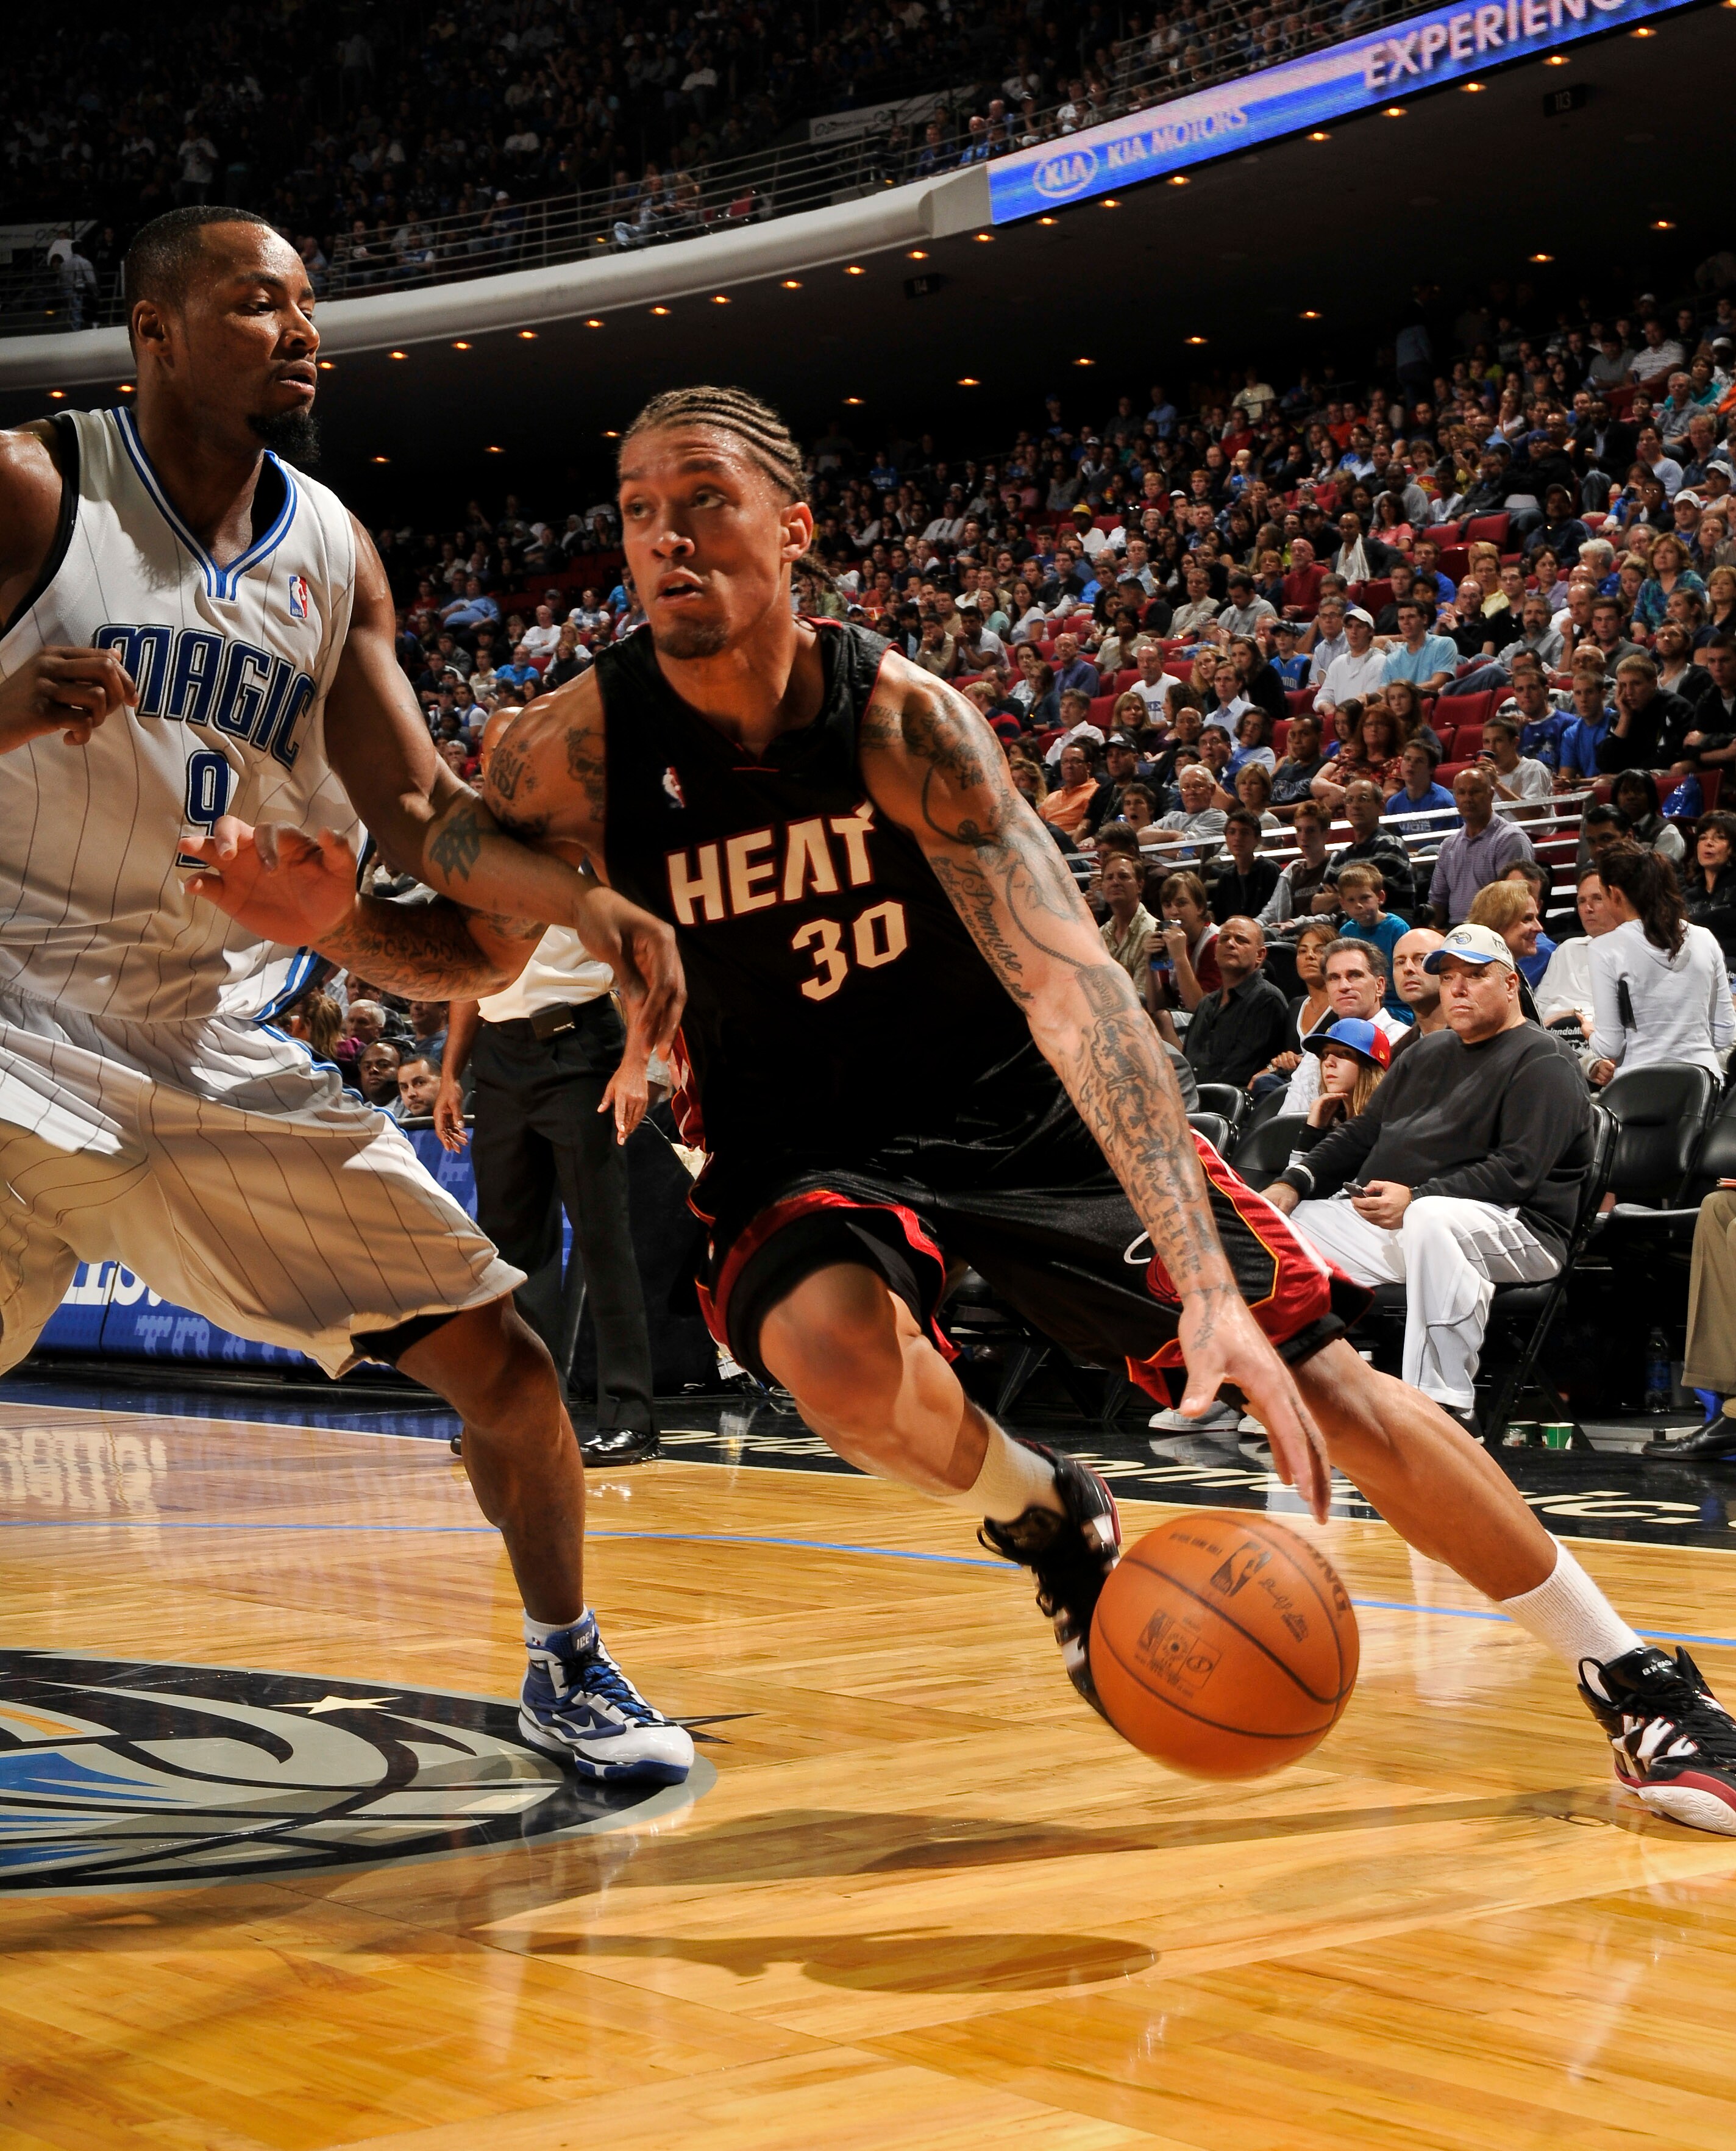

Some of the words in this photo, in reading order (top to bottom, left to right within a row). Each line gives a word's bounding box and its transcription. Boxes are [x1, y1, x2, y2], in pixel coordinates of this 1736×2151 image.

[1107, 137, 1147, 169] KIA
[1150, 107, 1248, 155] MOTORS
[93, 623, 316, 772] MAGIC
[176, 749, 232, 869] 9
[665, 799, 876, 926] HEAT
[791, 899, 909, 1003] 30
